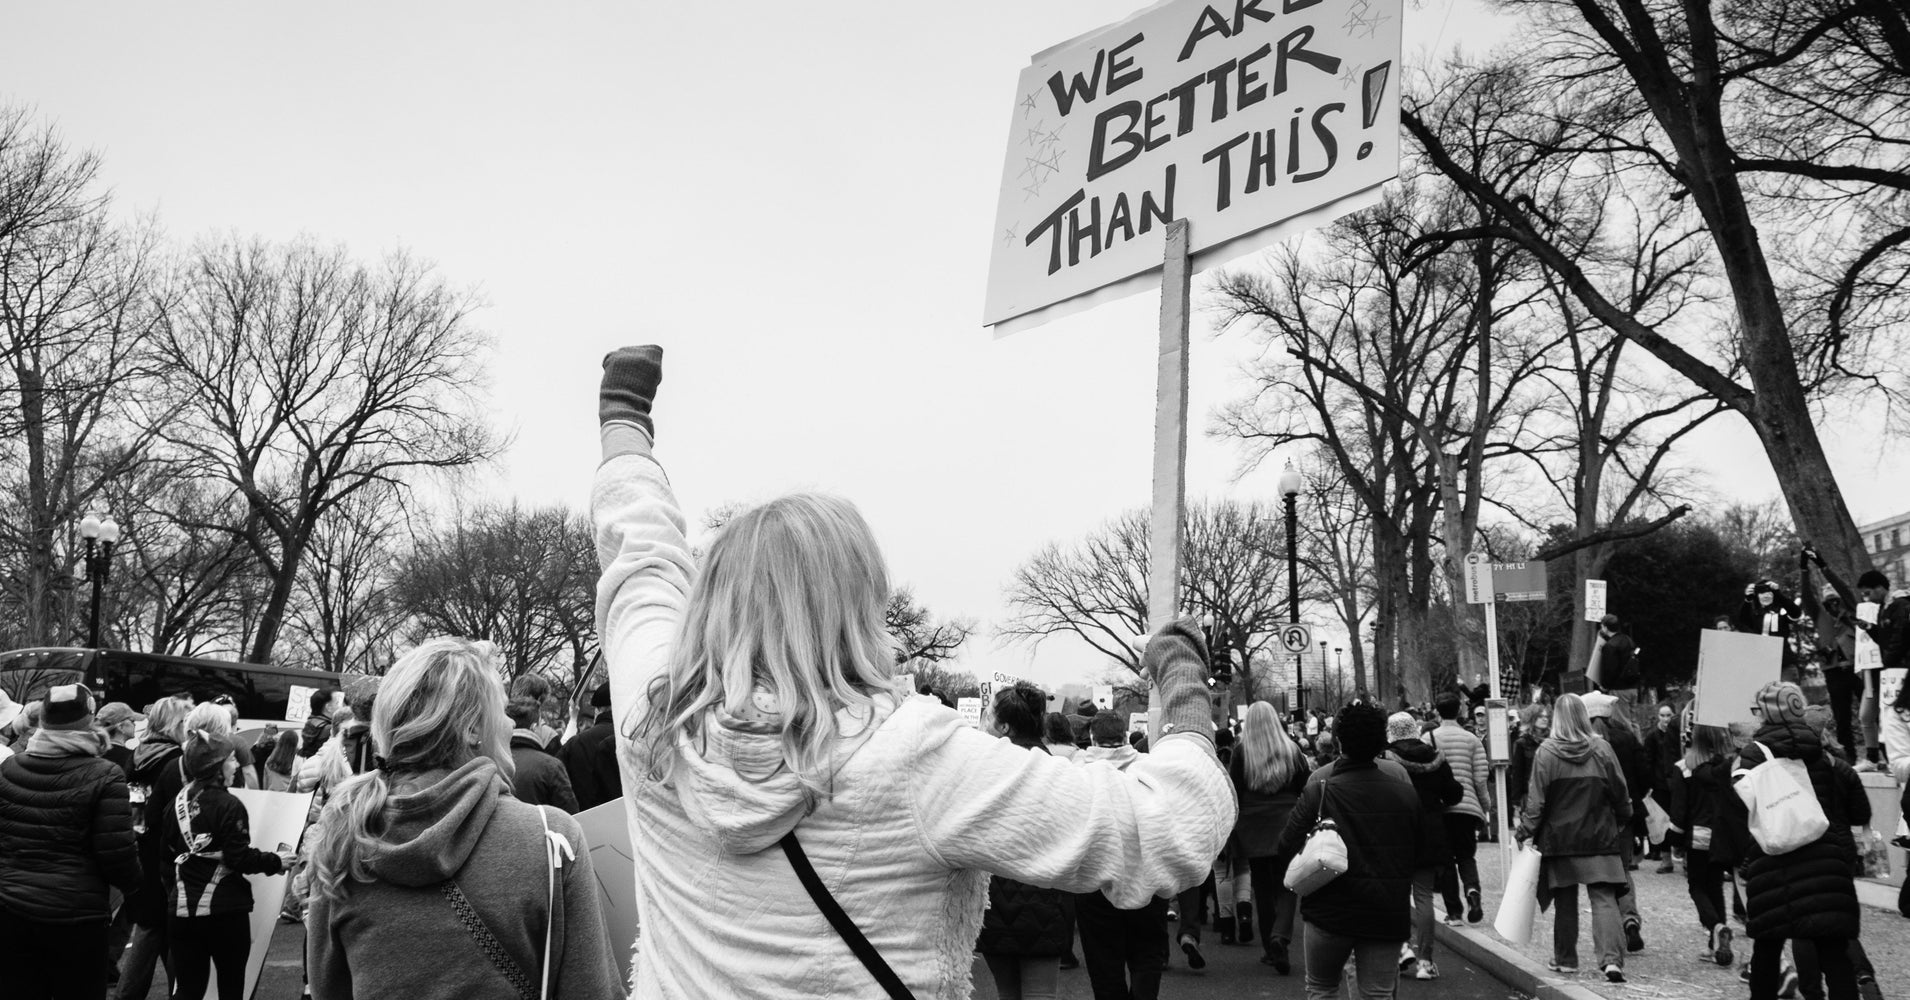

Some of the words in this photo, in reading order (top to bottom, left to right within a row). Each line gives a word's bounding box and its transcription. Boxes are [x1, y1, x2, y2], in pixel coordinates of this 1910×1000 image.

[1047, 32, 1145, 117] WE
[1177, 0, 1324, 62] AR
[1086, 25, 1342, 182] BETTER
[1025, 163, 1176, 276] THAN
[1470, 565, 1480, 602] metrobus
